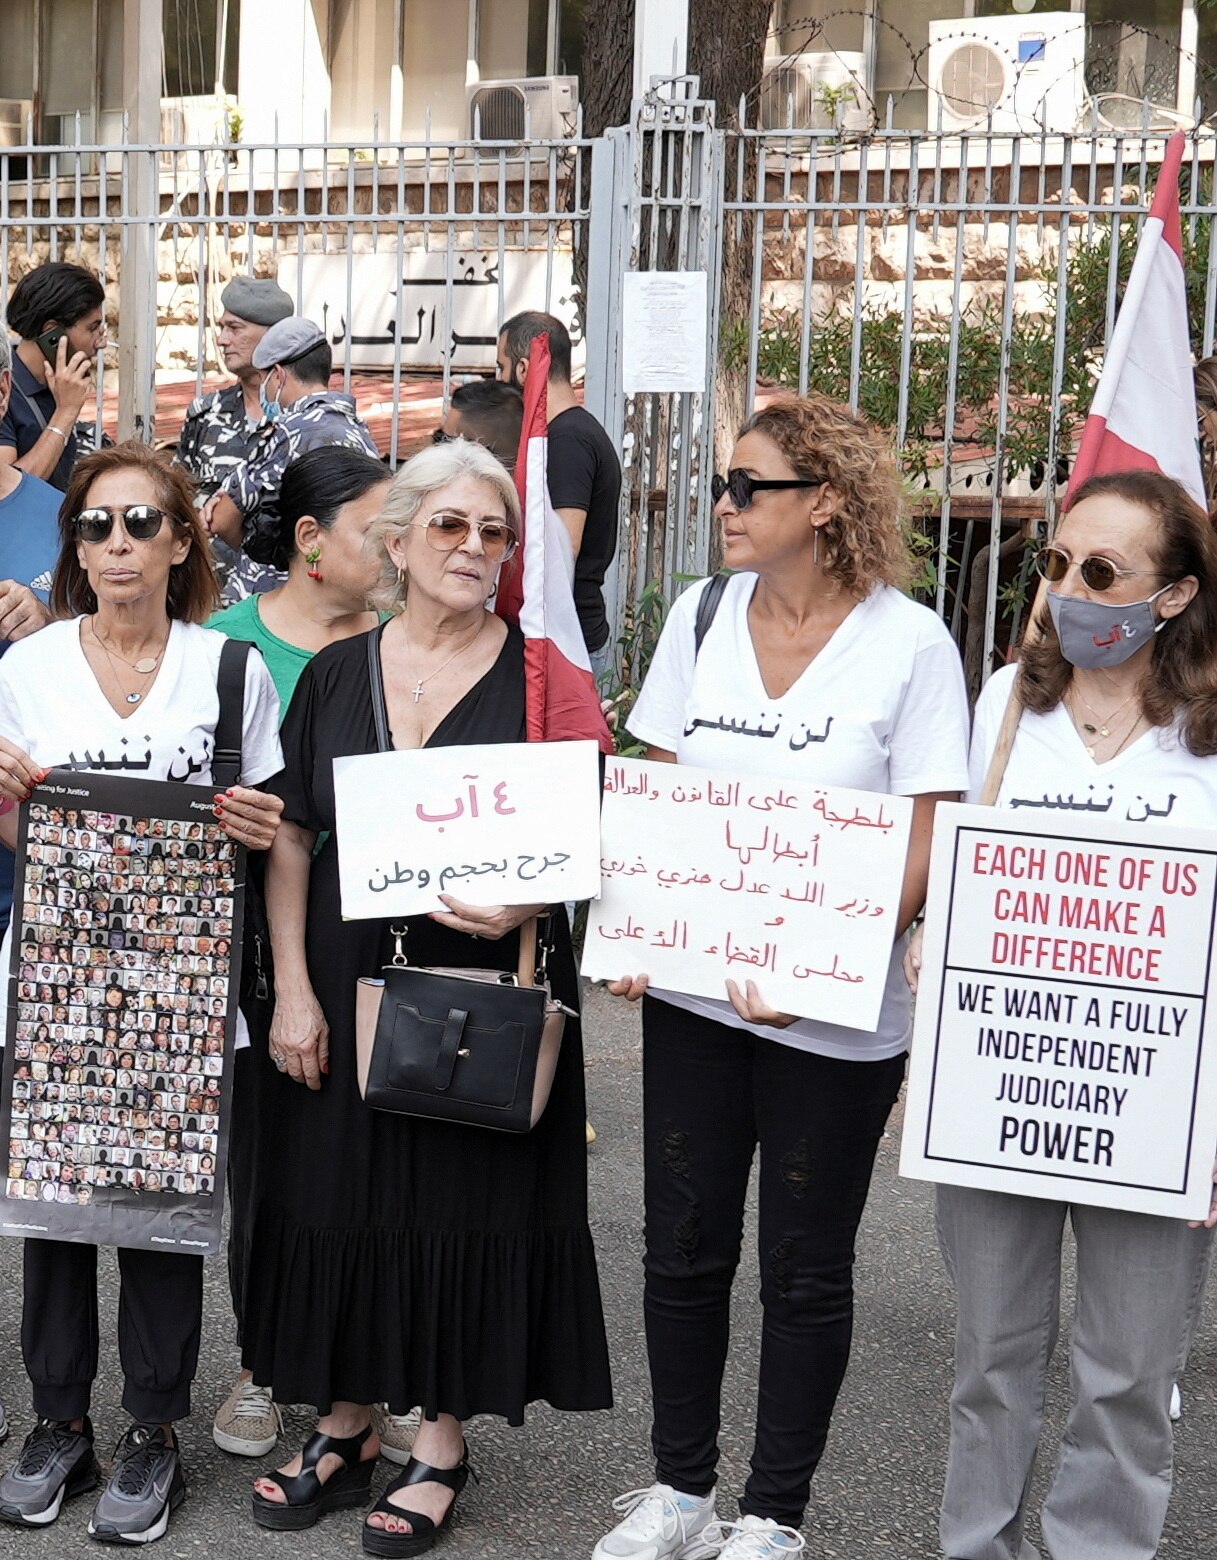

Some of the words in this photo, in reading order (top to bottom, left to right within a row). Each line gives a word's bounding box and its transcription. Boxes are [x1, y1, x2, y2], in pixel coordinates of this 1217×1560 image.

[683, 712, 783, 739] ننسى
[789, 716, 835, 751] لن
[415, 774, 479, 833] آب
[493, 781, 517, 816] ٤
[748, 789, 799, 811] على
[1126, 793, 1178, 822] لن
[368, 861, 431, 893] وطن
[439, 858, 508, 891] بحجم
[517, 852, 571, 881] جرح
[719, 869, 771, 894] عدل
[973, 842, 1046, 881] EACH
[1054, 850, 1111, 888] ONE
[1118, 857, 1155, 891] OF
[1162, 861, 1199, 897] US
[833, 898, 884, 918] وزير
[994, 888, 1050, 925] CAN
[1058, 895, 1141, 935] MAKE
[1148, 905, 1167, 938] A
[704, 931, 777, 972] القضاء
[991, 932, 1162, 982] DIFFERENCE
[957, 981, 996, 1015] WE
[1003, 987, 1079, 1024] WANT
[1084, 998, 1101, 1028] A
[1110, 1000, 1188, 1038] FULLY
[977, 1027, 1158, 1078] INDEPENDENT
[995, 1072, 1129, 1117] JUDICIARY
[999, 1115, 1115, 1167] POWER
